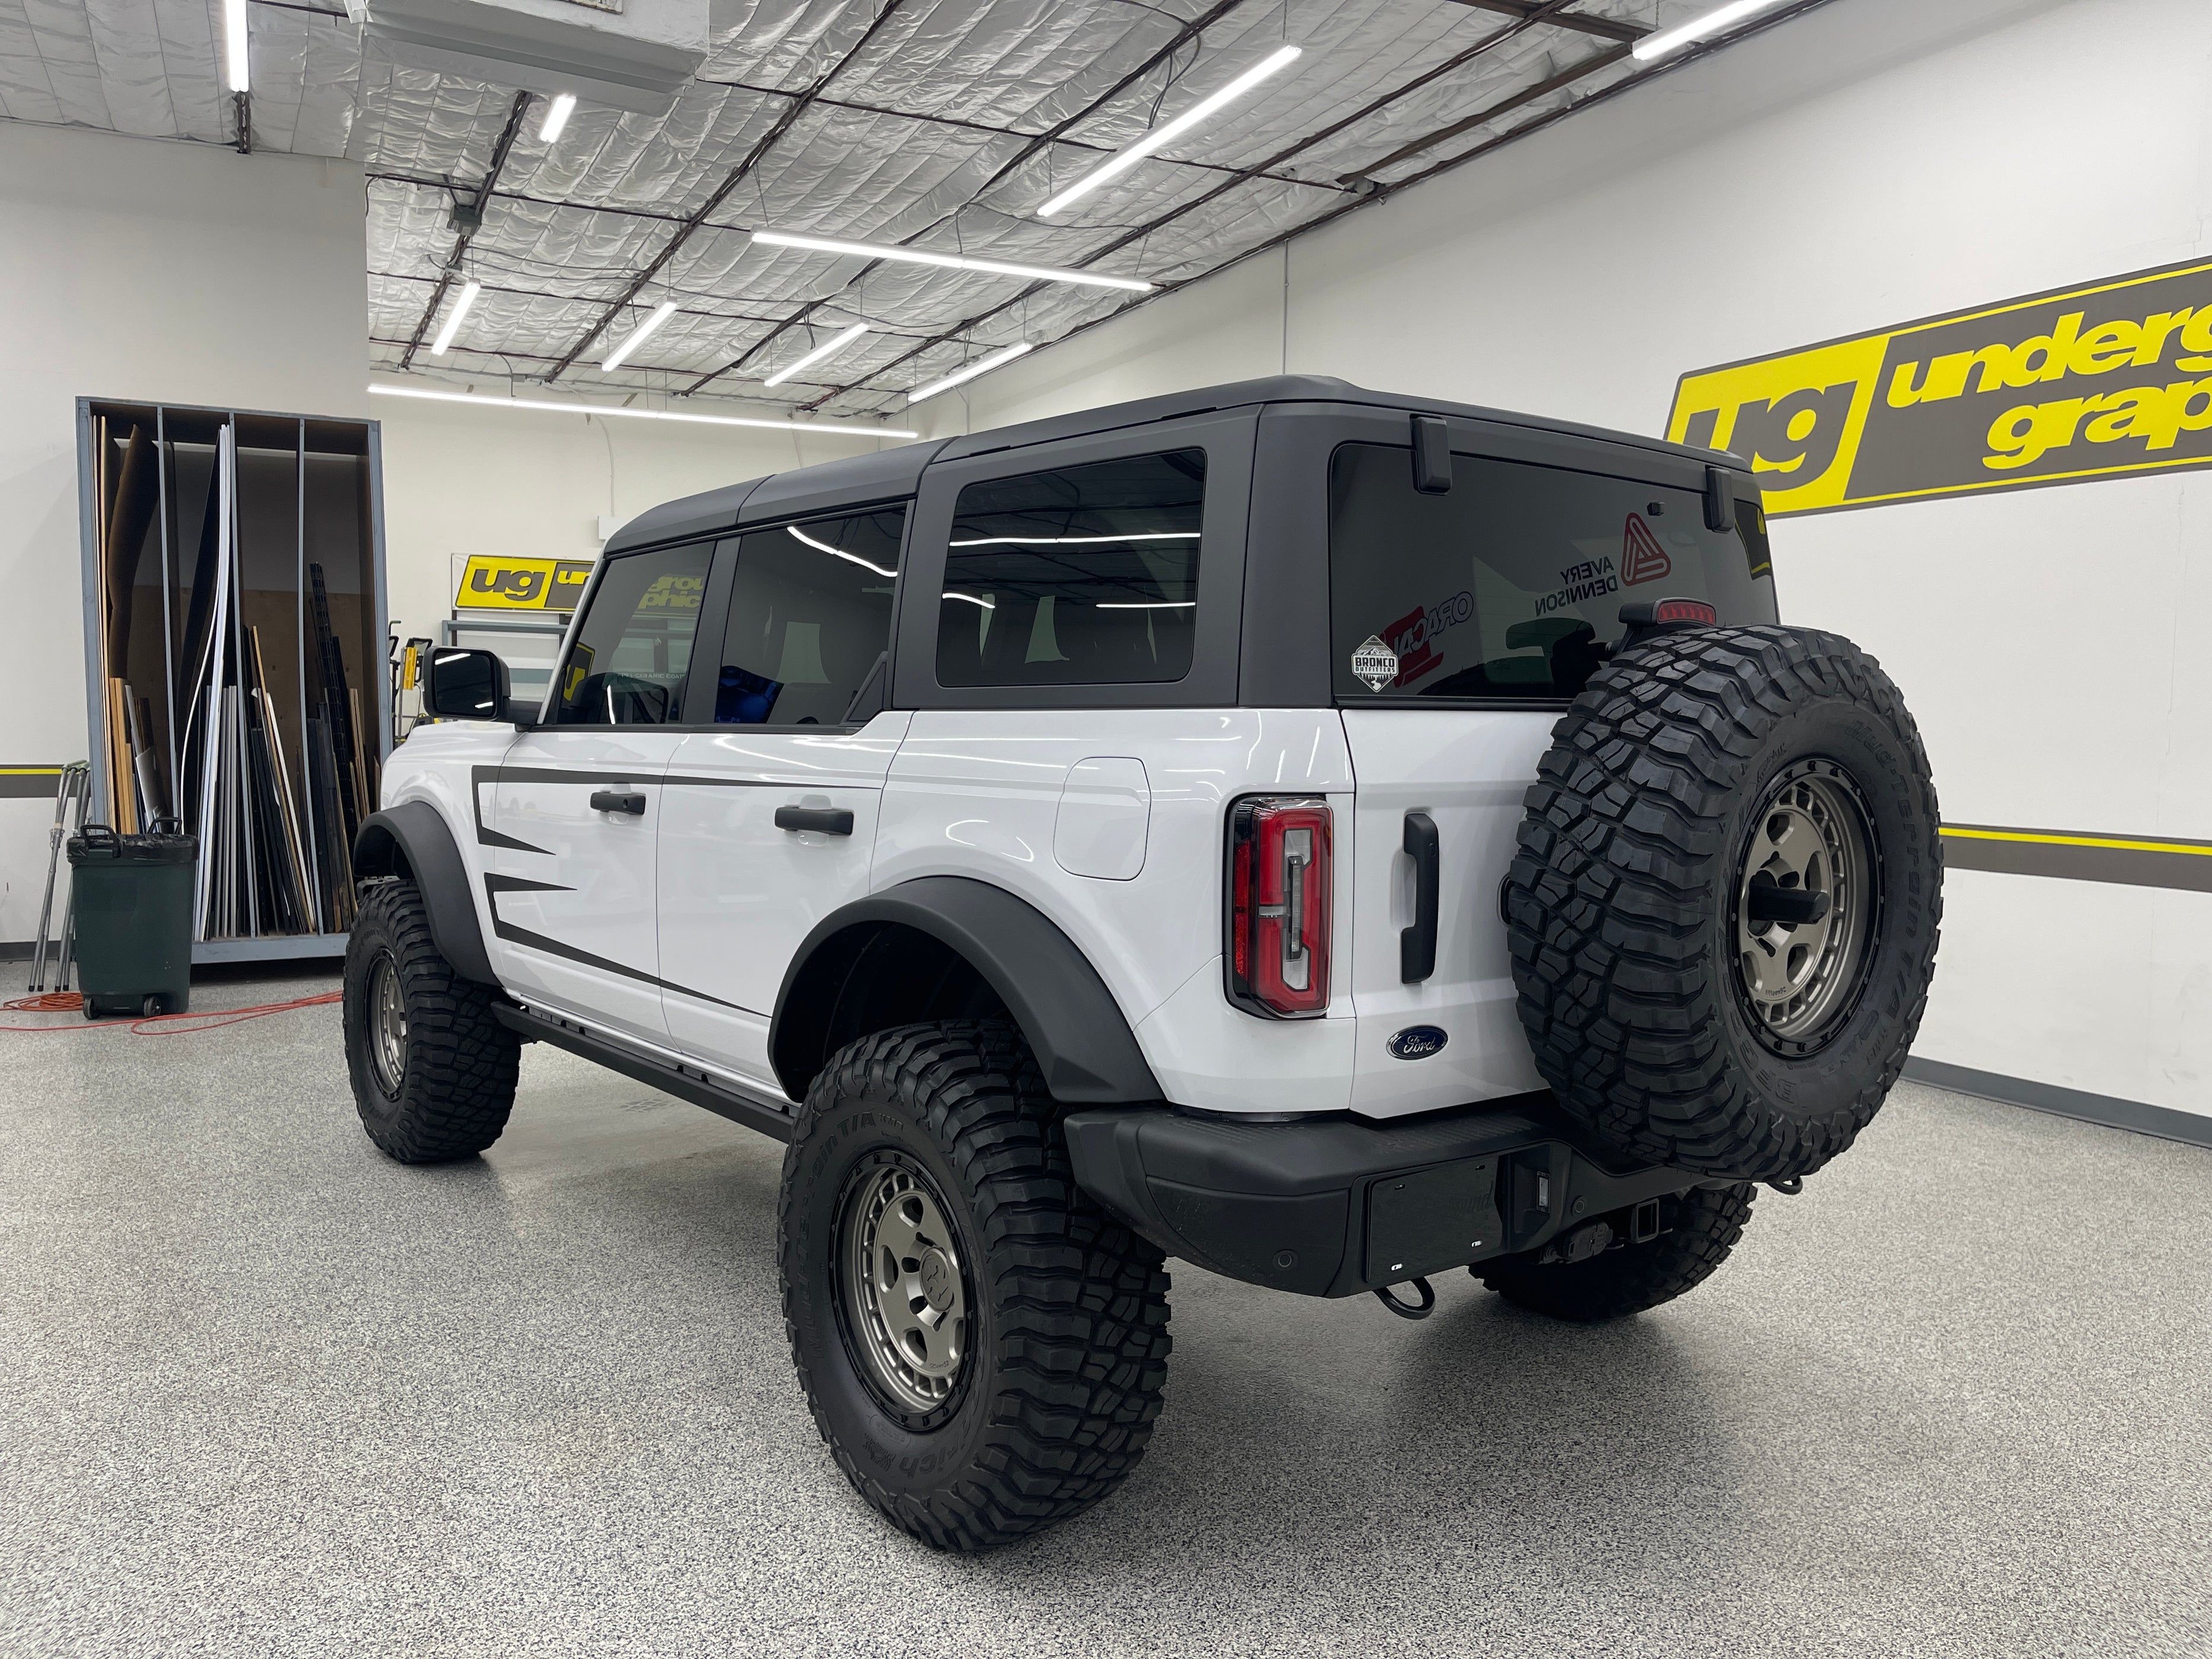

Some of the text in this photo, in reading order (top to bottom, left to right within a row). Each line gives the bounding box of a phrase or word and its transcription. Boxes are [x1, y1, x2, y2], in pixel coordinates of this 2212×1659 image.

[471, 569, 546, 601] ug
[1355, 657, 1395, 668] BRONCO
[1844, 720, 1922, 940] Mud-Terrain
[1403, 1035, 1435, 1053] Ford
